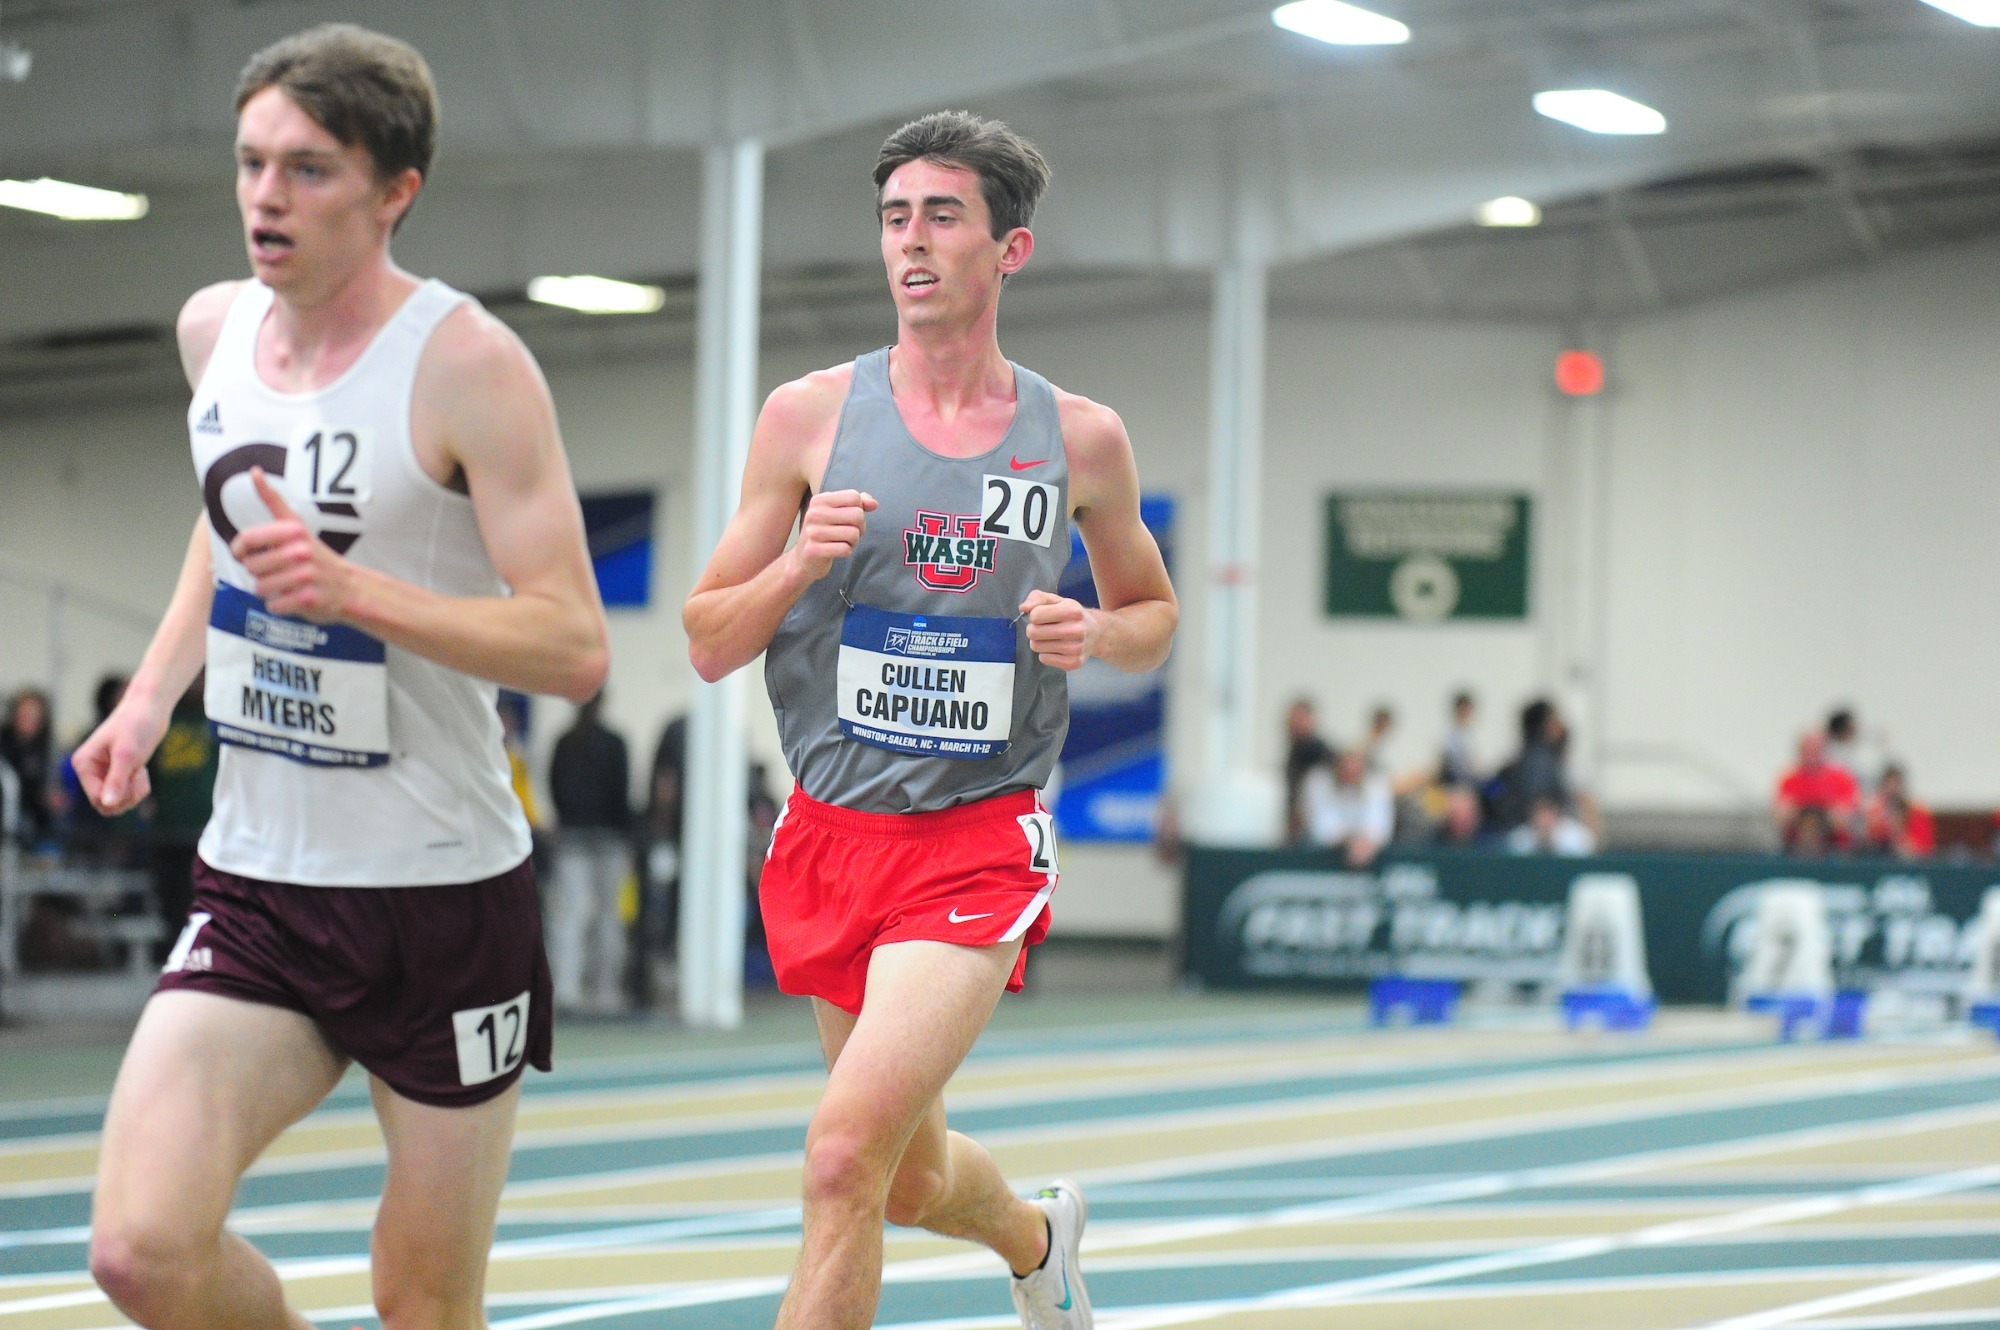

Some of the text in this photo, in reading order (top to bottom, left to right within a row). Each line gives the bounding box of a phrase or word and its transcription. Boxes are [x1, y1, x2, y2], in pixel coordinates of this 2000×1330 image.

[304, 429, 358, 495] 12
[983, 479, 1048, 541] 20
[905, 531, 997, 572] WASH
[908, 644, 956, 654] CHAMPIONSHIPS
[910, 635, 969, 648] TRACK & FIELD
[252, 653, 323, 694] HENRY
[881, 662, 967, 693] CULLEN
[242, 685, 336, 735] MYERS
[856, 688, 989, 731] CAPUANO
[852, 725, 918, 749] WINSTON-SALEM,
[920, 739, 933, 750] NC
[939, 741, 972, 753] MARCH
[972, 743, 992, 754] 11-12
[476, 1004, 521, 1075] 12
